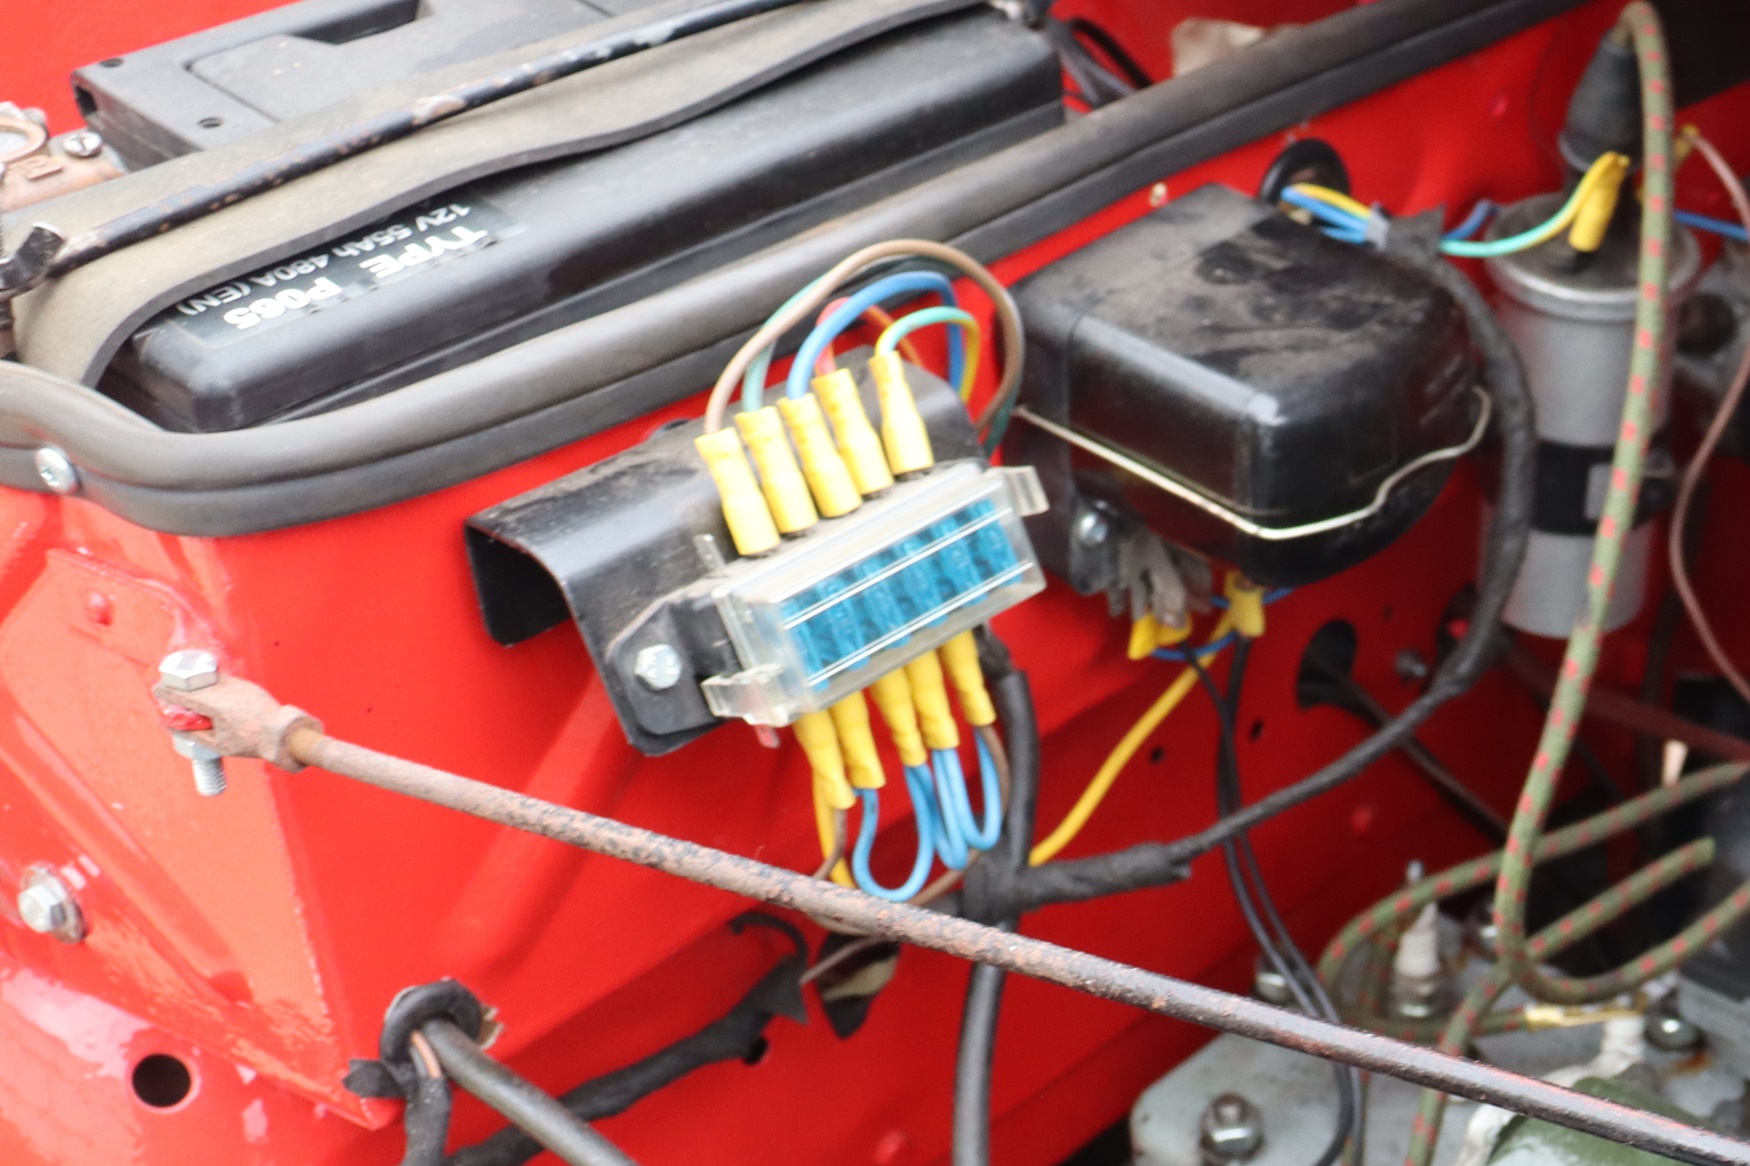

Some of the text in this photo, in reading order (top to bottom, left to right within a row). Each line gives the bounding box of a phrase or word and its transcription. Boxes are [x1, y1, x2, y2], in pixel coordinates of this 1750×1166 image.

[176, 203, 471, 316] 12V 55Ah 480A (EN)
[223, 225, 488, 330] TYPE P065
